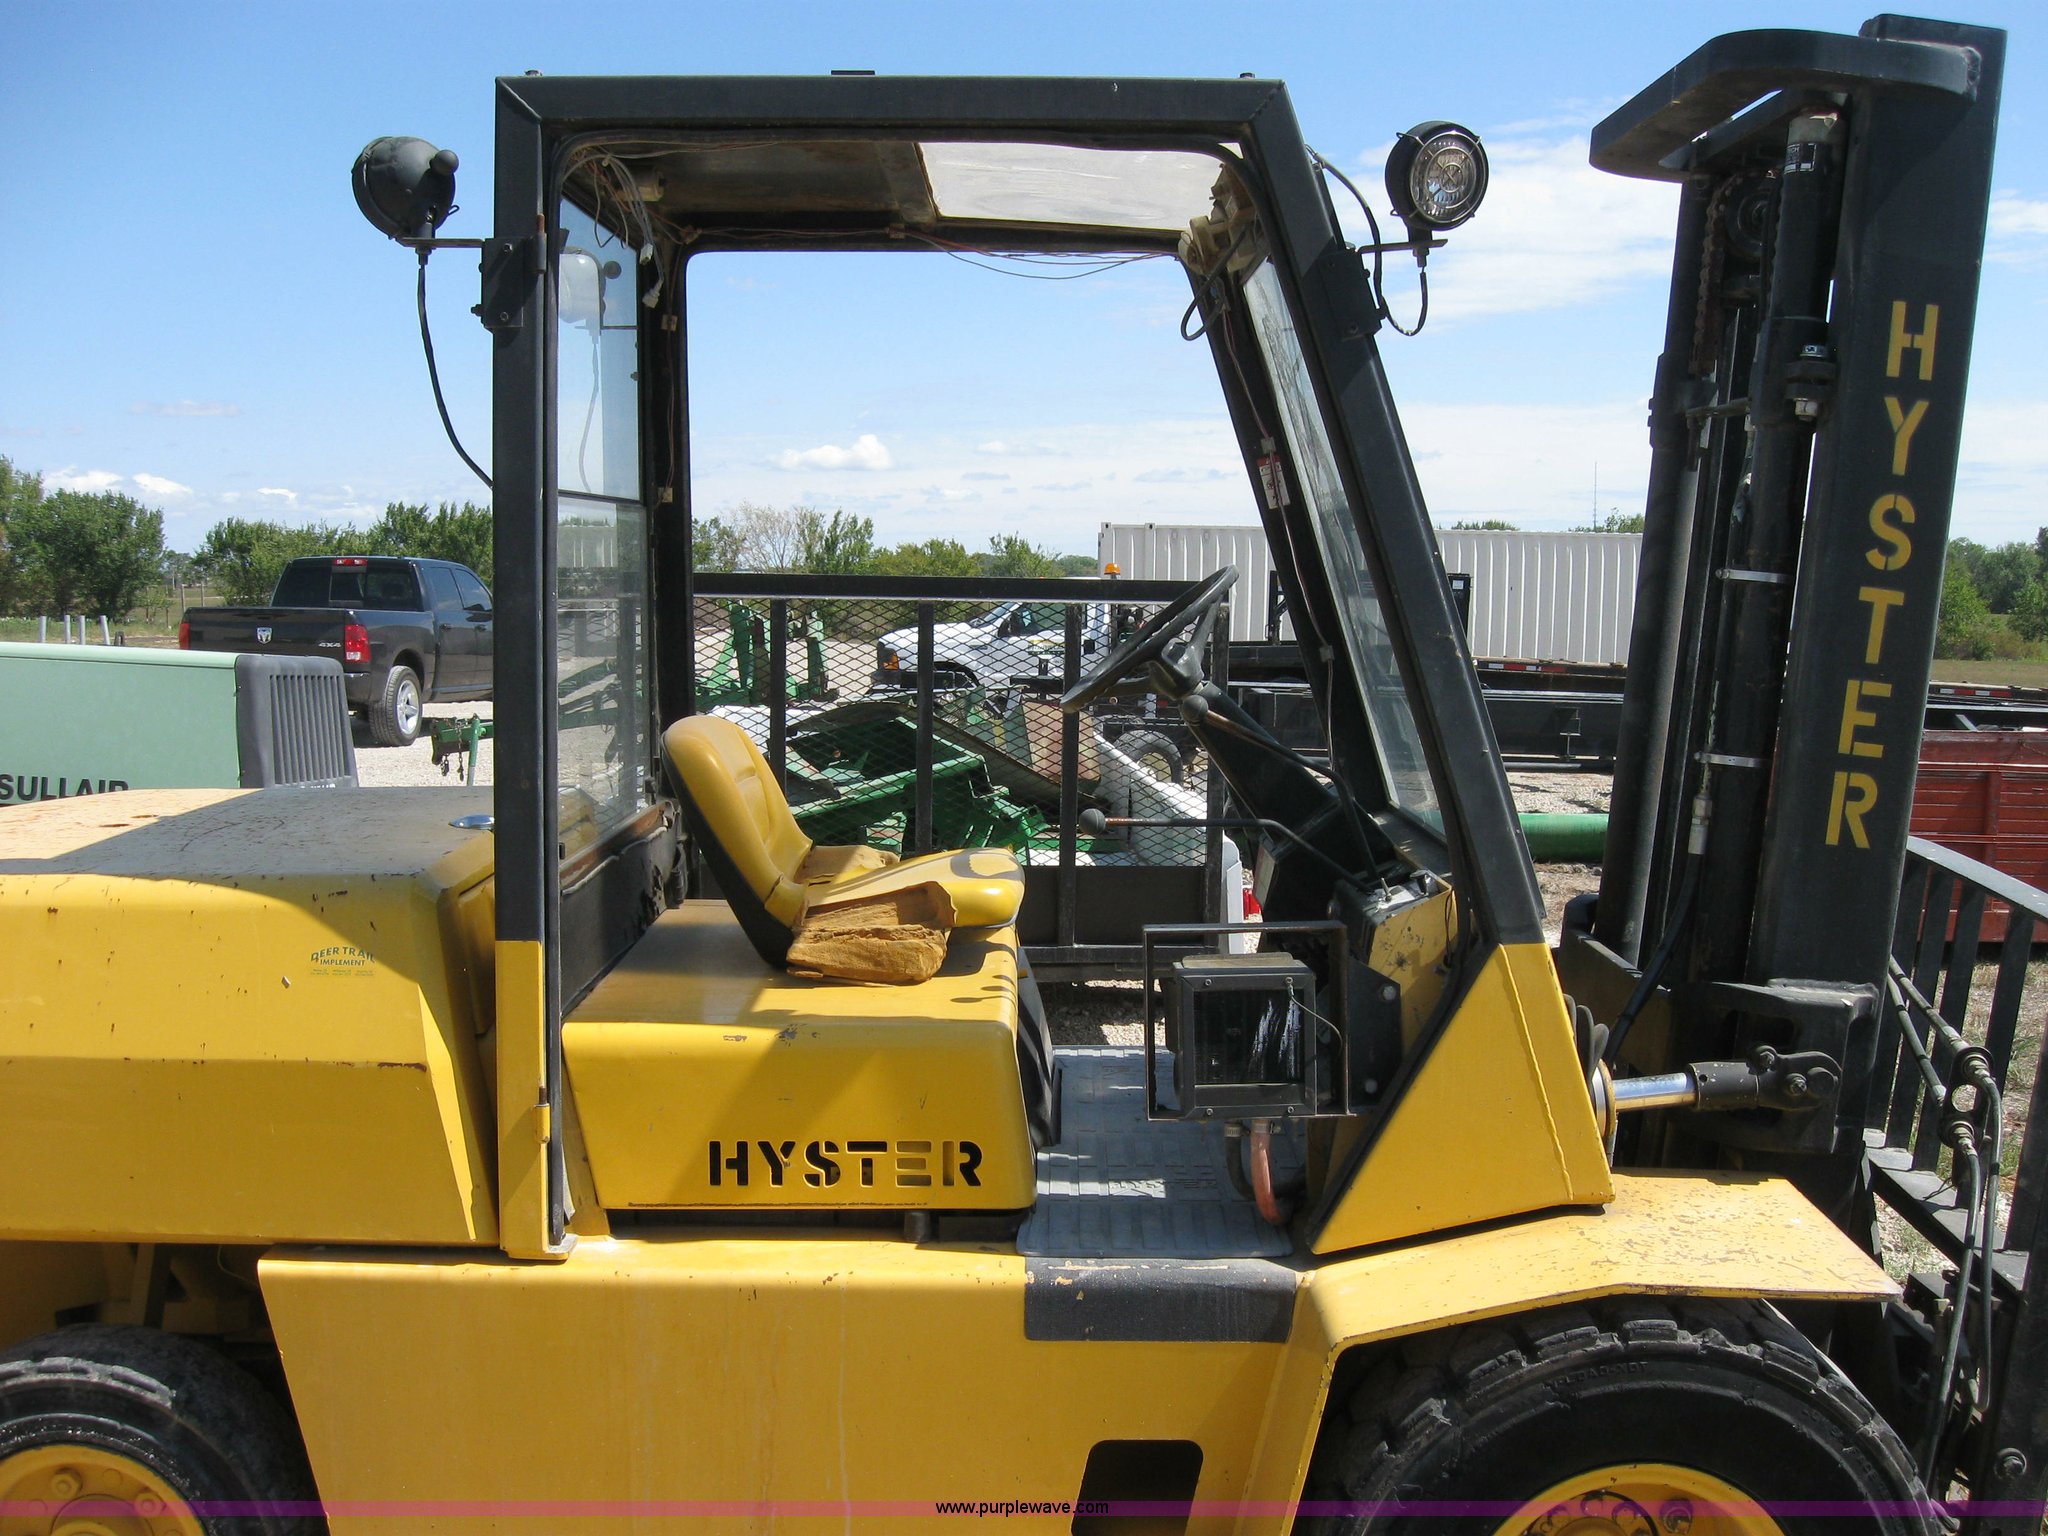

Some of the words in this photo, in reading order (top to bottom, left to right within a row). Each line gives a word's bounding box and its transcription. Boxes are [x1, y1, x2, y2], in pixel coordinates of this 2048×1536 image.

[1825, 299, 1939, 849] HYSTER
[311, 946, 339, 962] DEER
[342, 946, 376, 963] TRAIL
[708, 1140, 983, 1187] HYSTER
